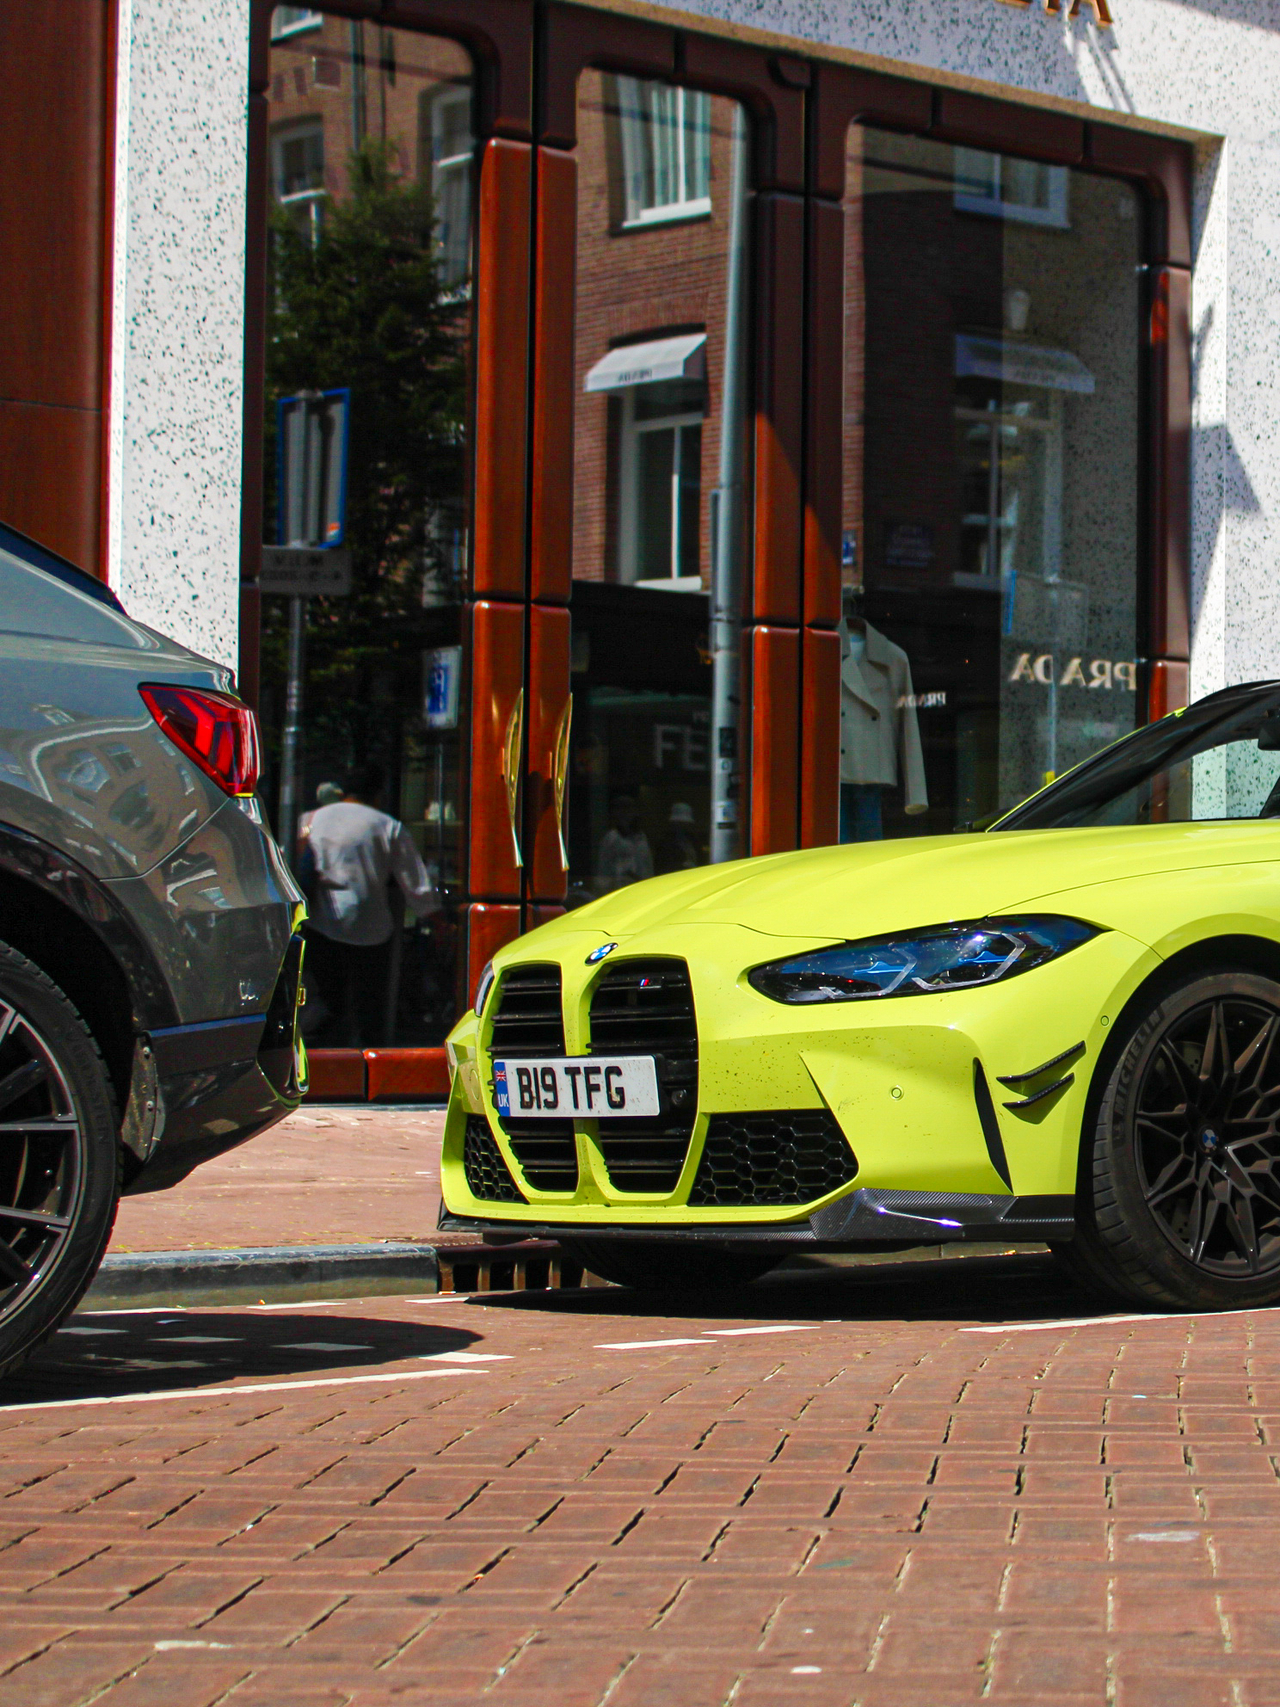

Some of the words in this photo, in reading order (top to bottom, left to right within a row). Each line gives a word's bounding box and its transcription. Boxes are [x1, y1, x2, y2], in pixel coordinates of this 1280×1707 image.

[1114, 1007, 1163, 1116] MICHELIN
[497, 1093, 509, 1107] UK
[516, 1066, 558, 1110] B19
[565, 1066, 626, 1110] TFG
